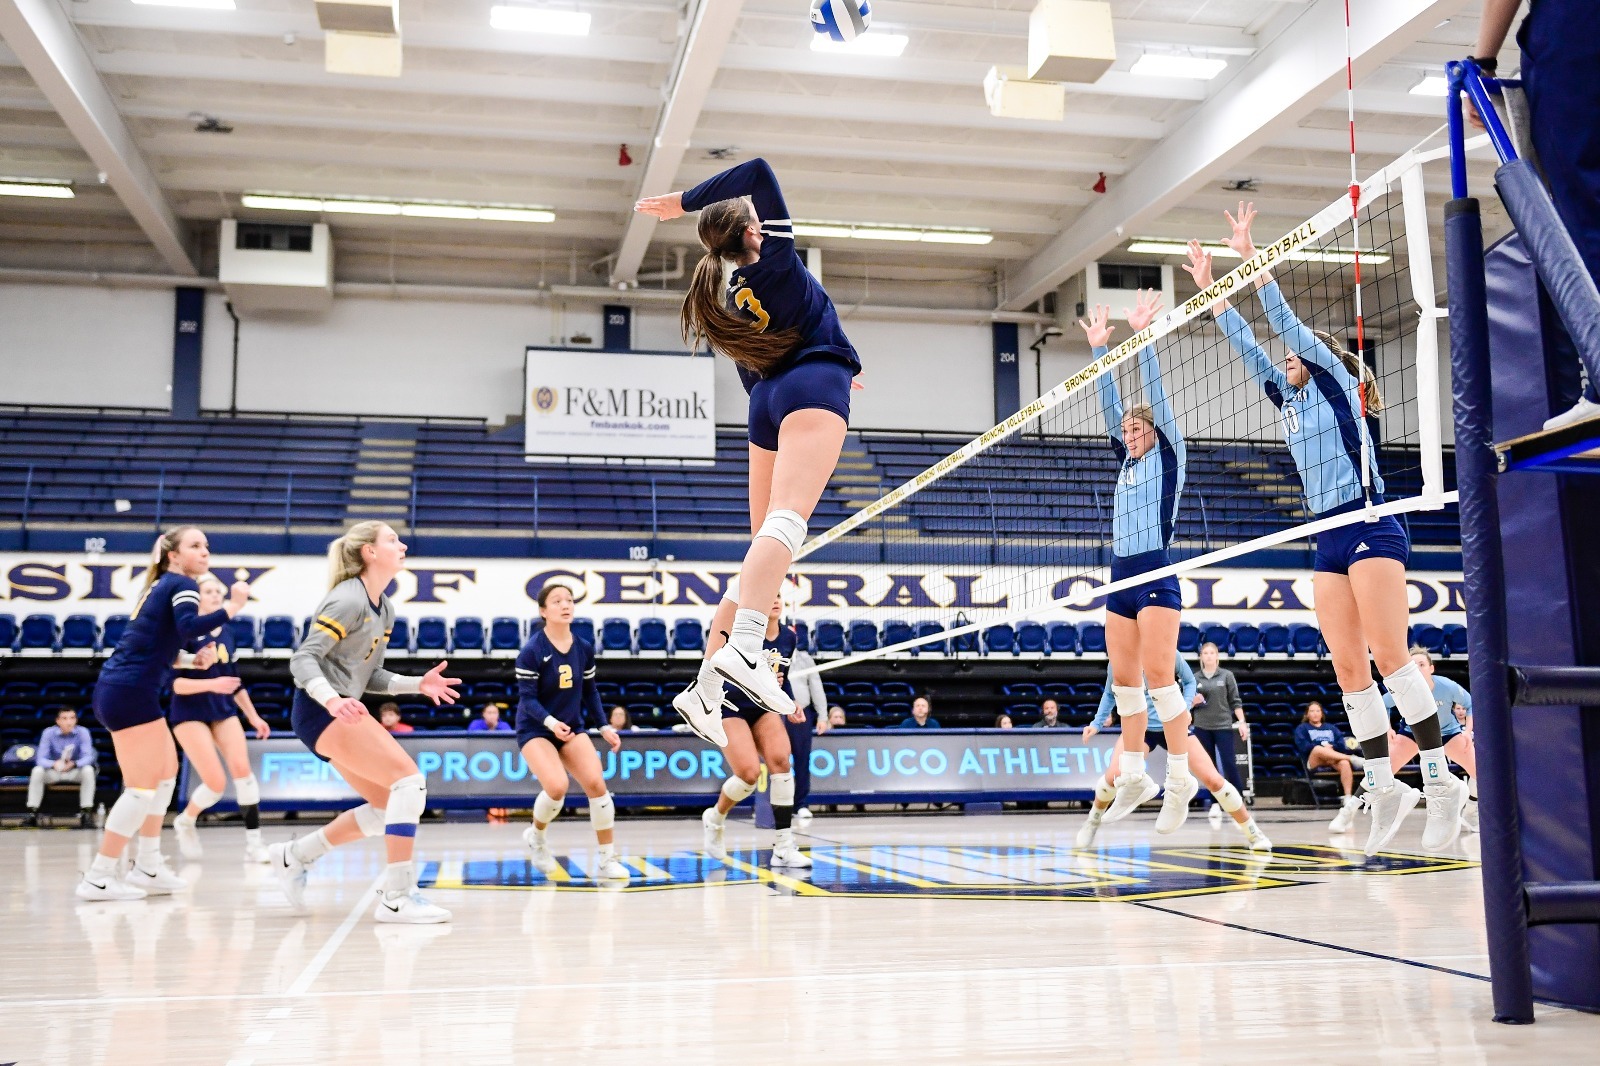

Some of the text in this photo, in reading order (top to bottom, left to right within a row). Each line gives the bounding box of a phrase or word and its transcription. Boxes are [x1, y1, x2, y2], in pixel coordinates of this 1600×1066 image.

[1185, 222, 1316, 316] BRONCHO VOLLEYBALL
[734, 287, 771, 334] 3
[1000, 352, 1016, 363] 204
[1064, 327, 1154, 392] BRONCHO VOLLEYBALL
[564, 386, 709, 420] F&M Bank
[591, 420, 671, 432] fmbankok.com
[980, 399, 1045, 446] BRONCHO VOLLEYBALL
[629, 546, 648, 560] 103
[384, 568, 477, 604] F
[525, 569, 1008, 609] CENRAL
[558, 664, 574, 689] 2
[417, 751, 538, 782] PROU
[808, 749, 857, 778] OF
[867, 748, 948, 777] UCO
